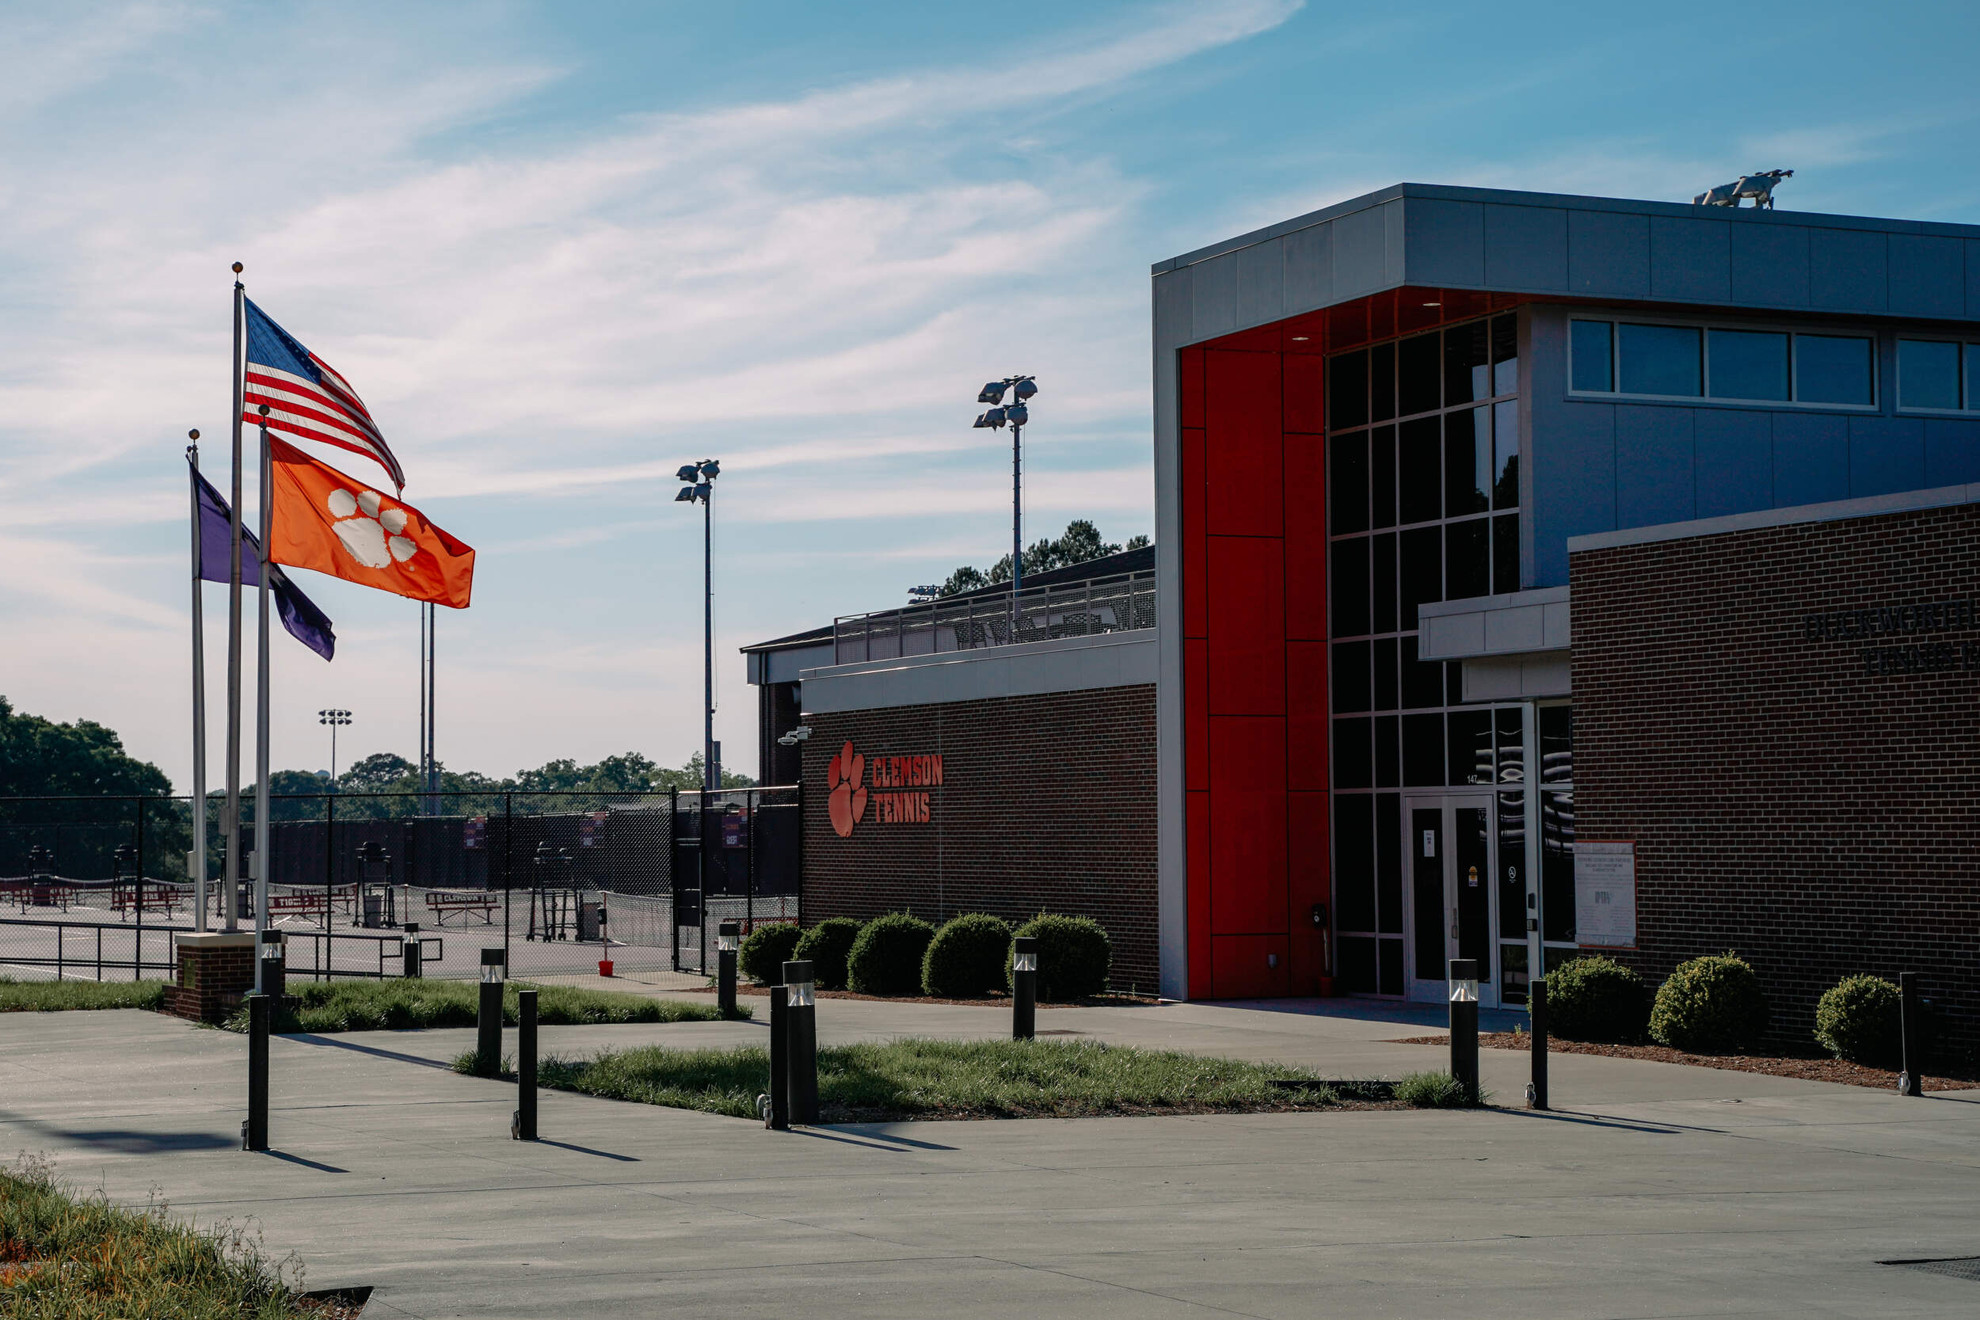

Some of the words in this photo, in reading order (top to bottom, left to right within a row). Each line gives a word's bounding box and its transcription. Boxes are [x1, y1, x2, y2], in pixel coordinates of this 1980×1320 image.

[1861, 644, 1954, 675] TENNIS
[872, 754, 943, 788] CLEMSON
[873, 792, 930, 823] TENNIS
